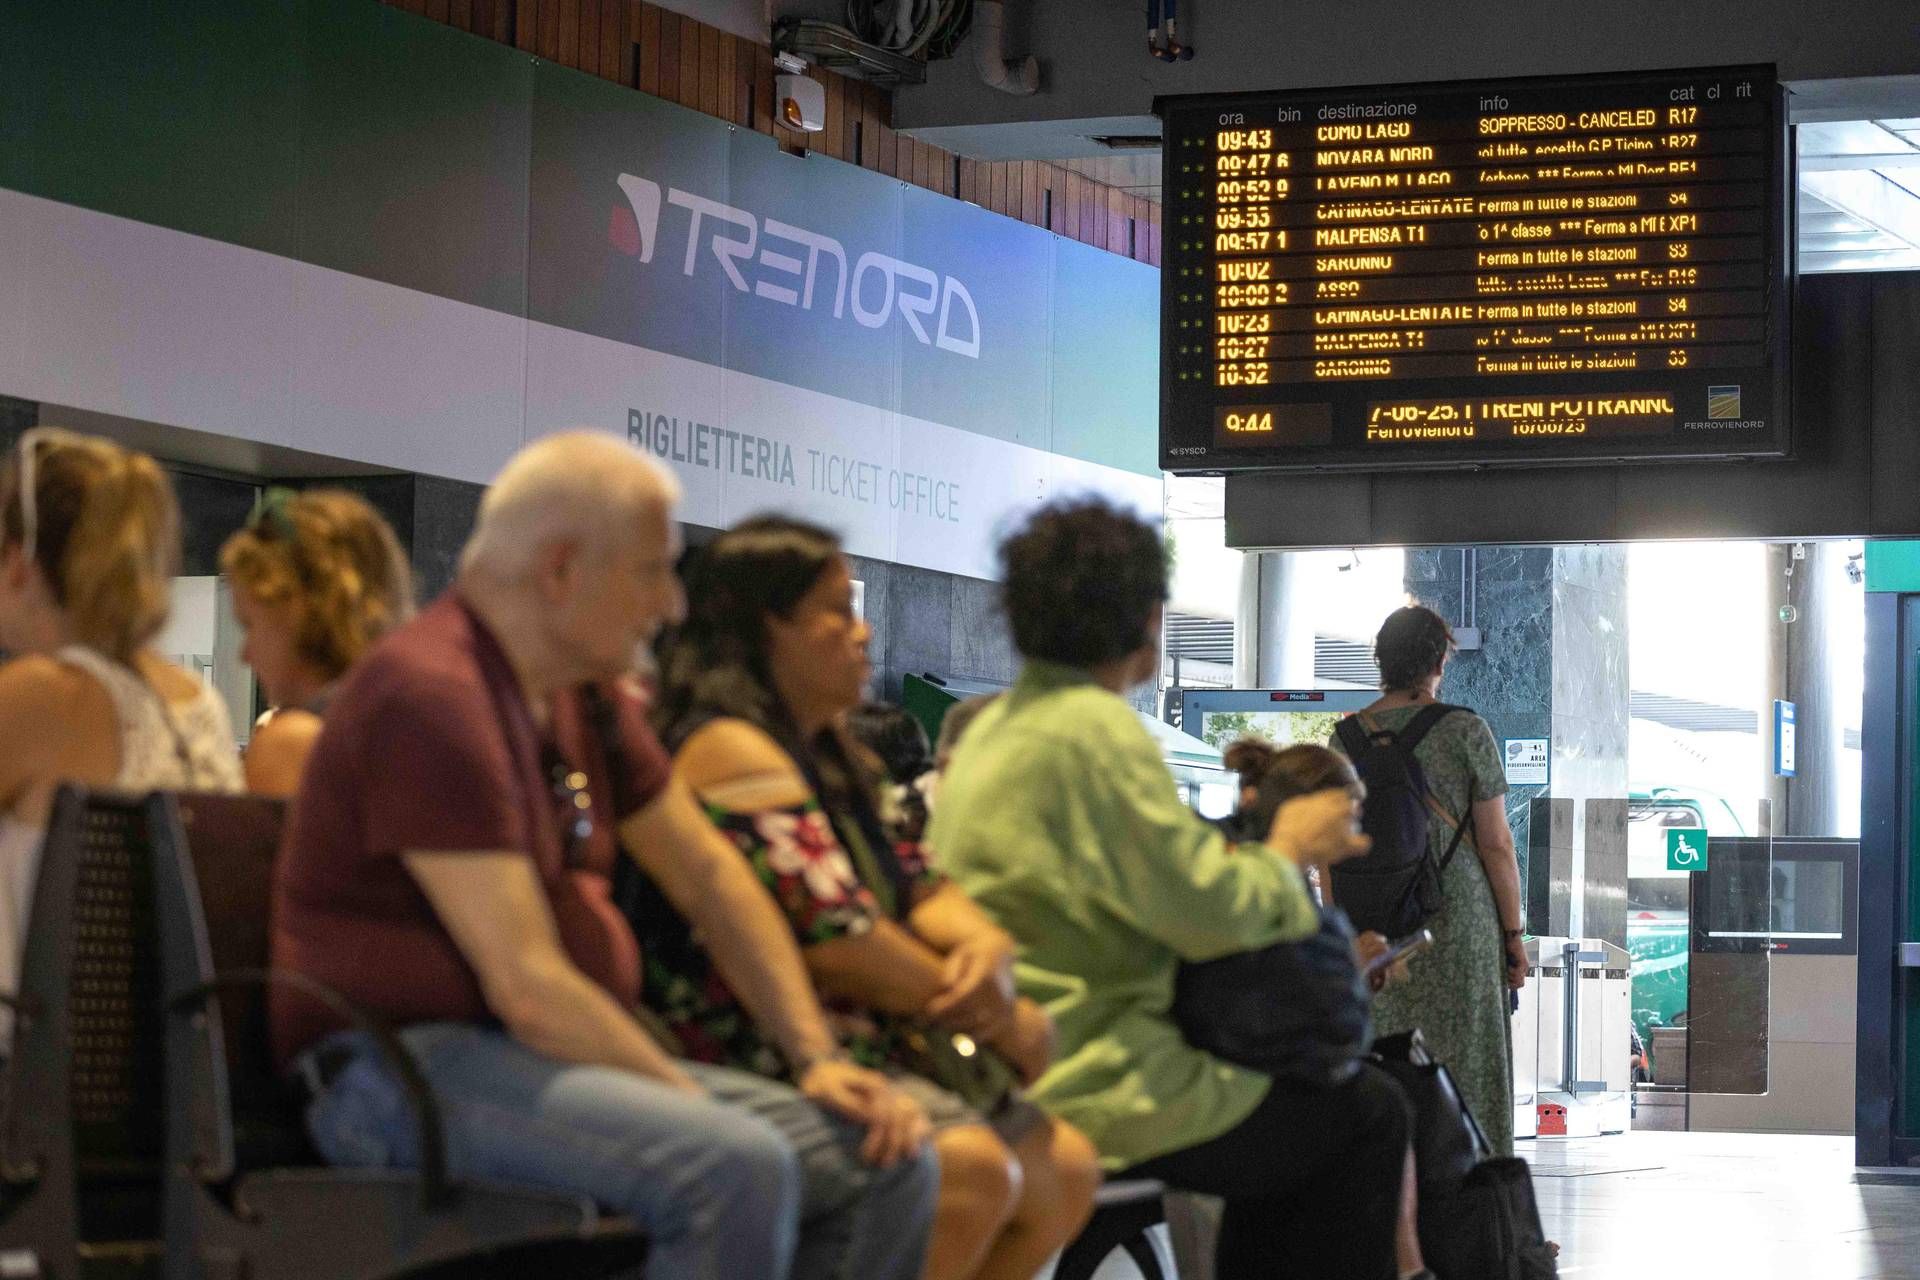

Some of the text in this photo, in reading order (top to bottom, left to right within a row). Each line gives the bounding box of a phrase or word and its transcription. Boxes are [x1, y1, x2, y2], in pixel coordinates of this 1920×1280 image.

[1669, 85, 1696, 101] cat
[1706, 83, 1721, 98] cl
[1735, 82, 1752, 97] rit
[1317, 102, 1417, 120] destinazione
[1479, 96, 1509, 111] info
[1218, 111, 1245, 126] ora
[1277, 107, 1301, 122] bin
[1479, 114, 1566, 134] SOPPRESSO
[1579, 109, 1656, 129] CANCELED
[1669, 107, 1697, 125] R17
[1217, 129, 1272, 152] 09:43
[1317, 122, 1411, 142] COMO LAGO
[1669, 134, 1697, 148] R27
[1317, 146, 1433, 166] NOVARA NORD
[1511, 222, 1552, 239] classe
[1584, 218, 1627, 235] Ferma
[1629, 221, 1638, 234] a
[1669, 214, 1696, 232] XP1
[1276, 230, 1287, 249] 1
[1316, 225, 1425, 246] MALPENSA T1
[1478, 247, 1637, 266] Ferma in tutte le stazioni
[1668, 243, 1688, 259] S3
[1217, 261, 1271, 282] 10:02
[1316, 255, 1393, 273] SARONNO
[667, 187, 981, 360] TRENORD
[1478, 300, 1637, 320] Ferma in tutte le stazioni
[1668, 297, 1687, 313] S4
[1226, 412, 1273, 432] 9:44
[1684, 421, 1765, 430] FERROVIENORD
[1179, 448, 1206, 456] SYSCO
[627, 407, 960, 523] BIGLIETTERIA TICKET OFFICE
